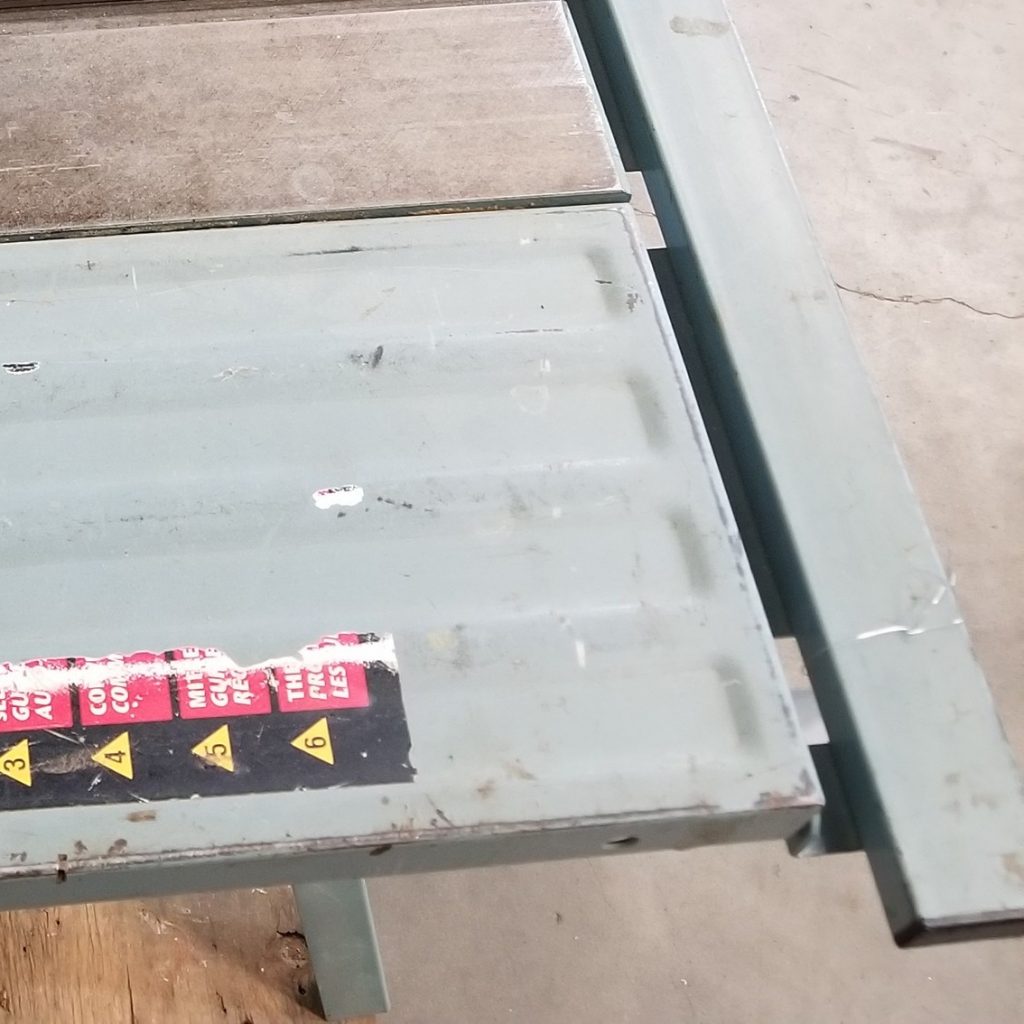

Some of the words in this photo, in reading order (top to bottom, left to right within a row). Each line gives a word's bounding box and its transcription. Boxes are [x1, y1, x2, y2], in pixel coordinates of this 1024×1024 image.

[304, 735, 327, 749] 6
[104, 750, 126, 764] 4
[205, 742, 227, 758] 5
[3, 757, 26, 772] 3
